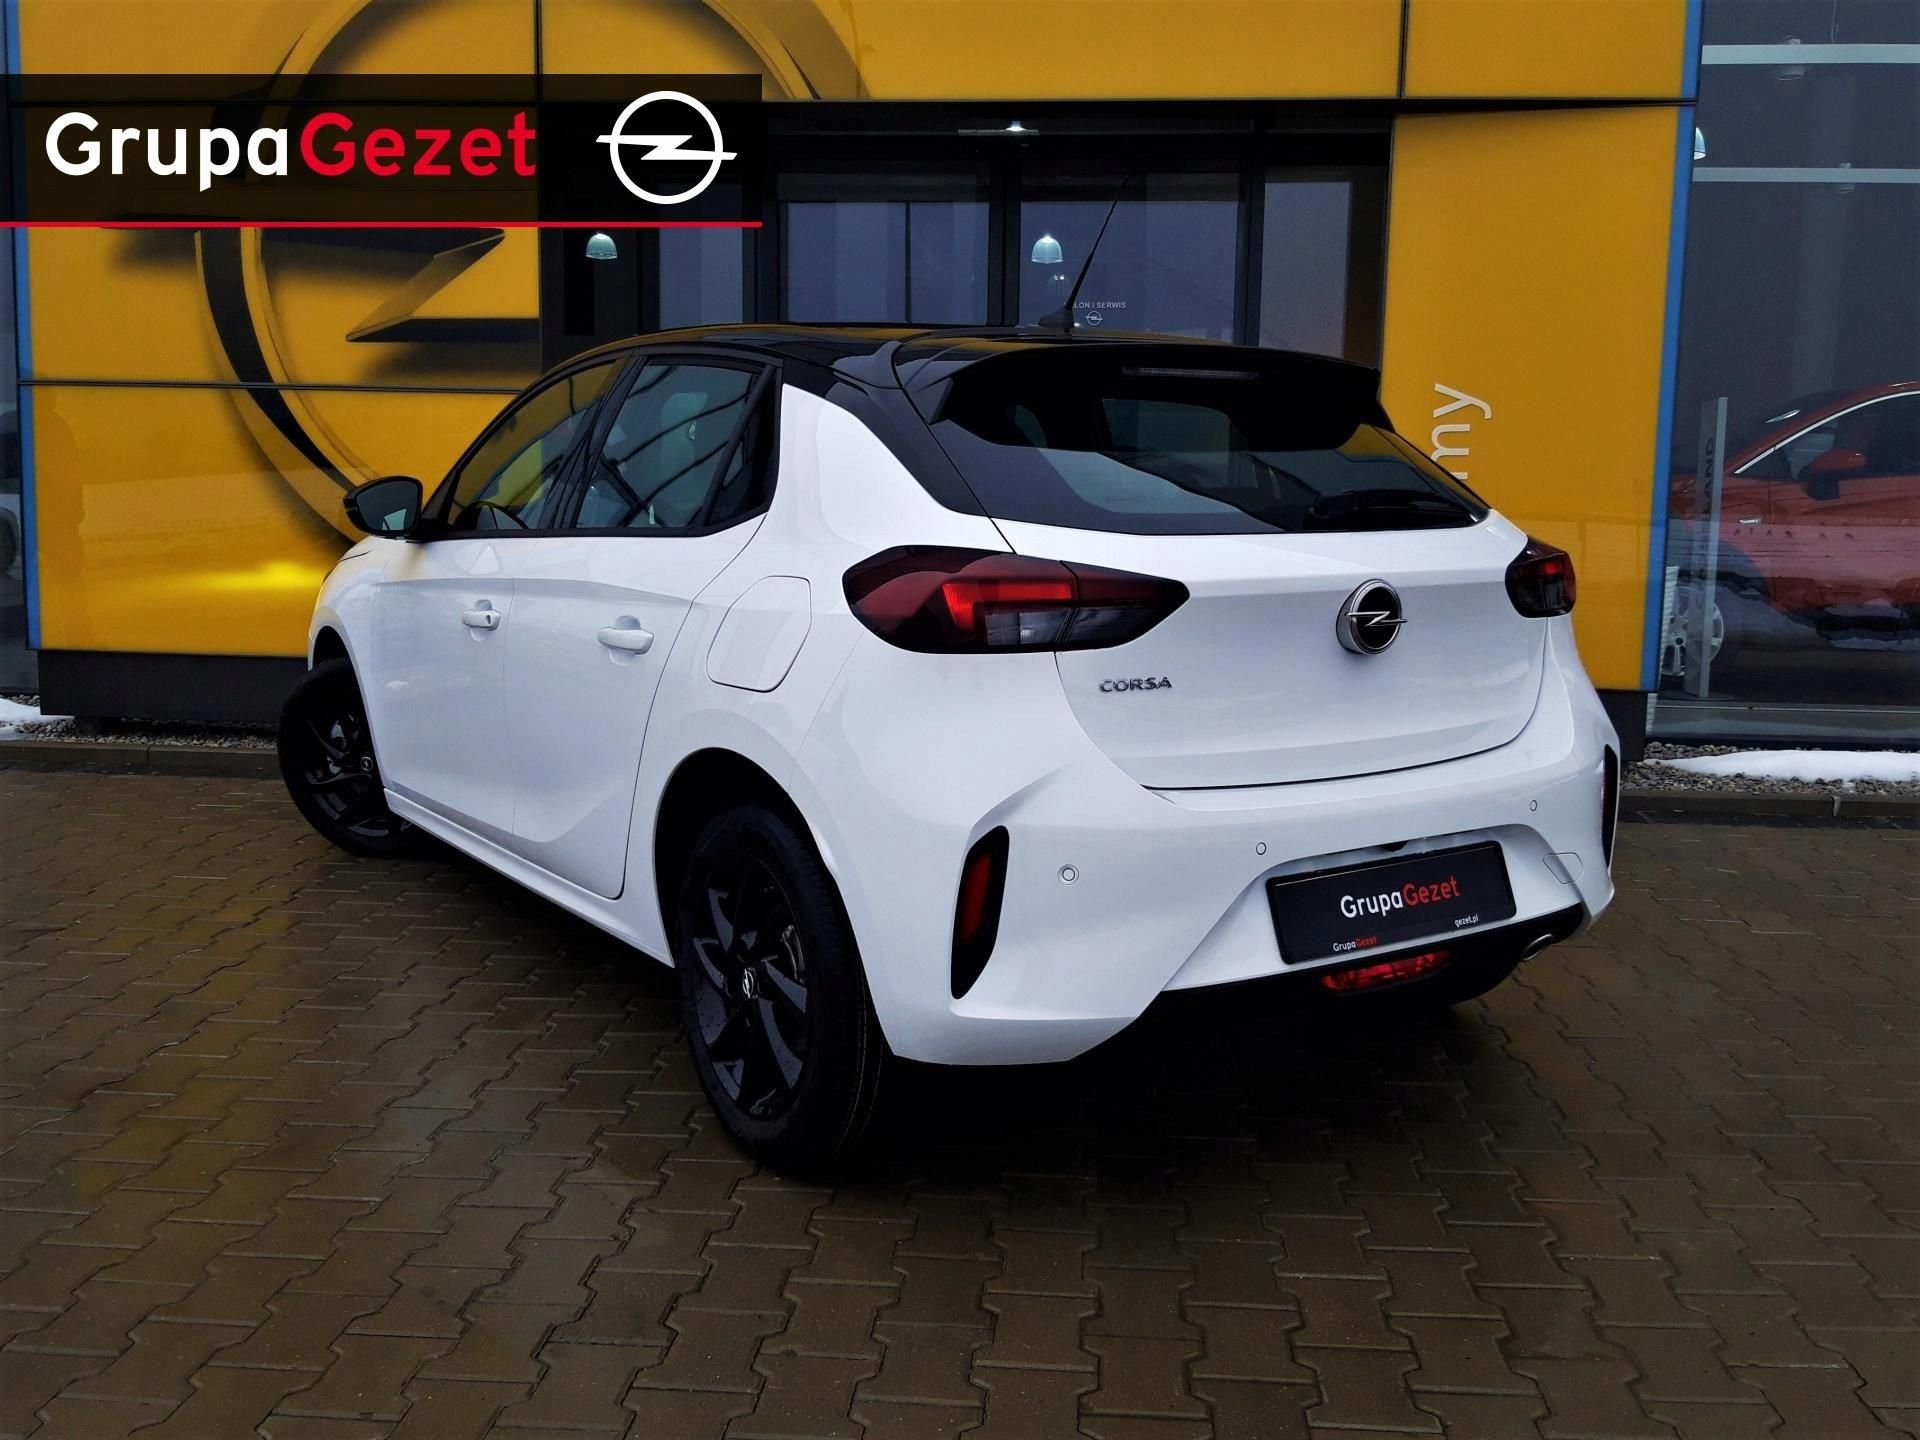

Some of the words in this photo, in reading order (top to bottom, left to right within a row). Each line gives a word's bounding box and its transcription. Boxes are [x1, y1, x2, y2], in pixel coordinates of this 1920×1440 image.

[1073, 301, 1090, 309] LON
[1096, 301, 1127, 309] SERWIS
[1099, 676, 1172, 692] CORSA
[1454, 913, 1479, 928] gezet.pl
